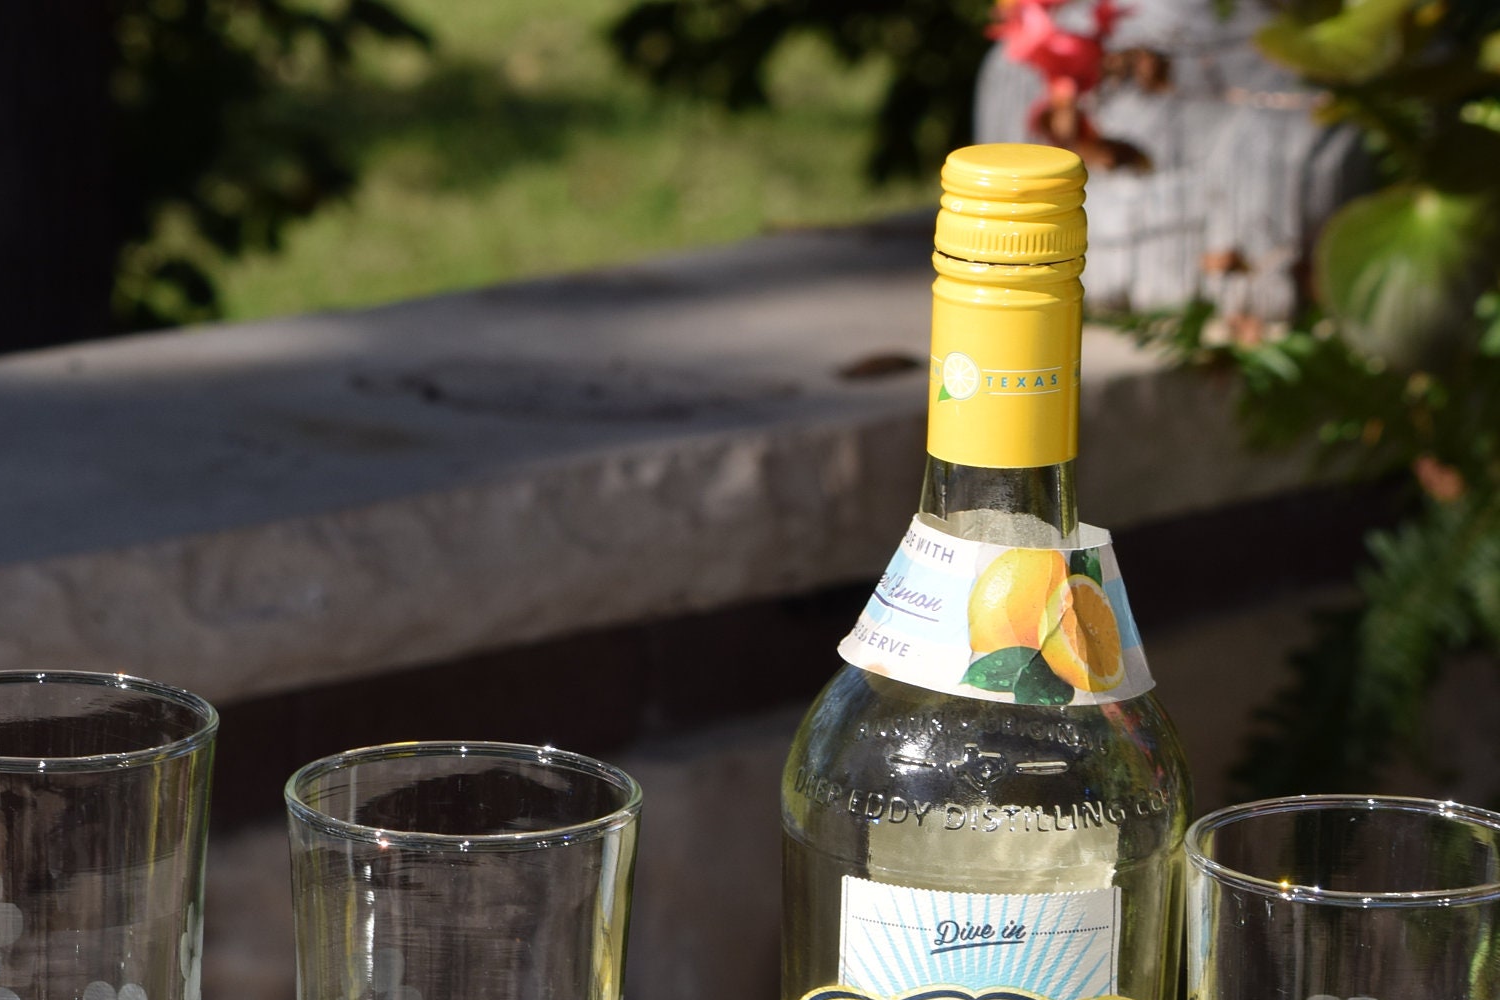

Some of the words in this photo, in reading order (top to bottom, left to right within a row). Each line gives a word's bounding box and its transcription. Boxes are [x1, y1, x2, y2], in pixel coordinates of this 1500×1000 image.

[985, 374, 1058, 388] TEXAS
[916, 537, 955, 564] WITH
[848, 789, 932, 827] EDDY
[944, 800, 1127, 832] DISTILLING
[933, 920, 996, 946] Dive
[1000, 919, 1027, 940] in
